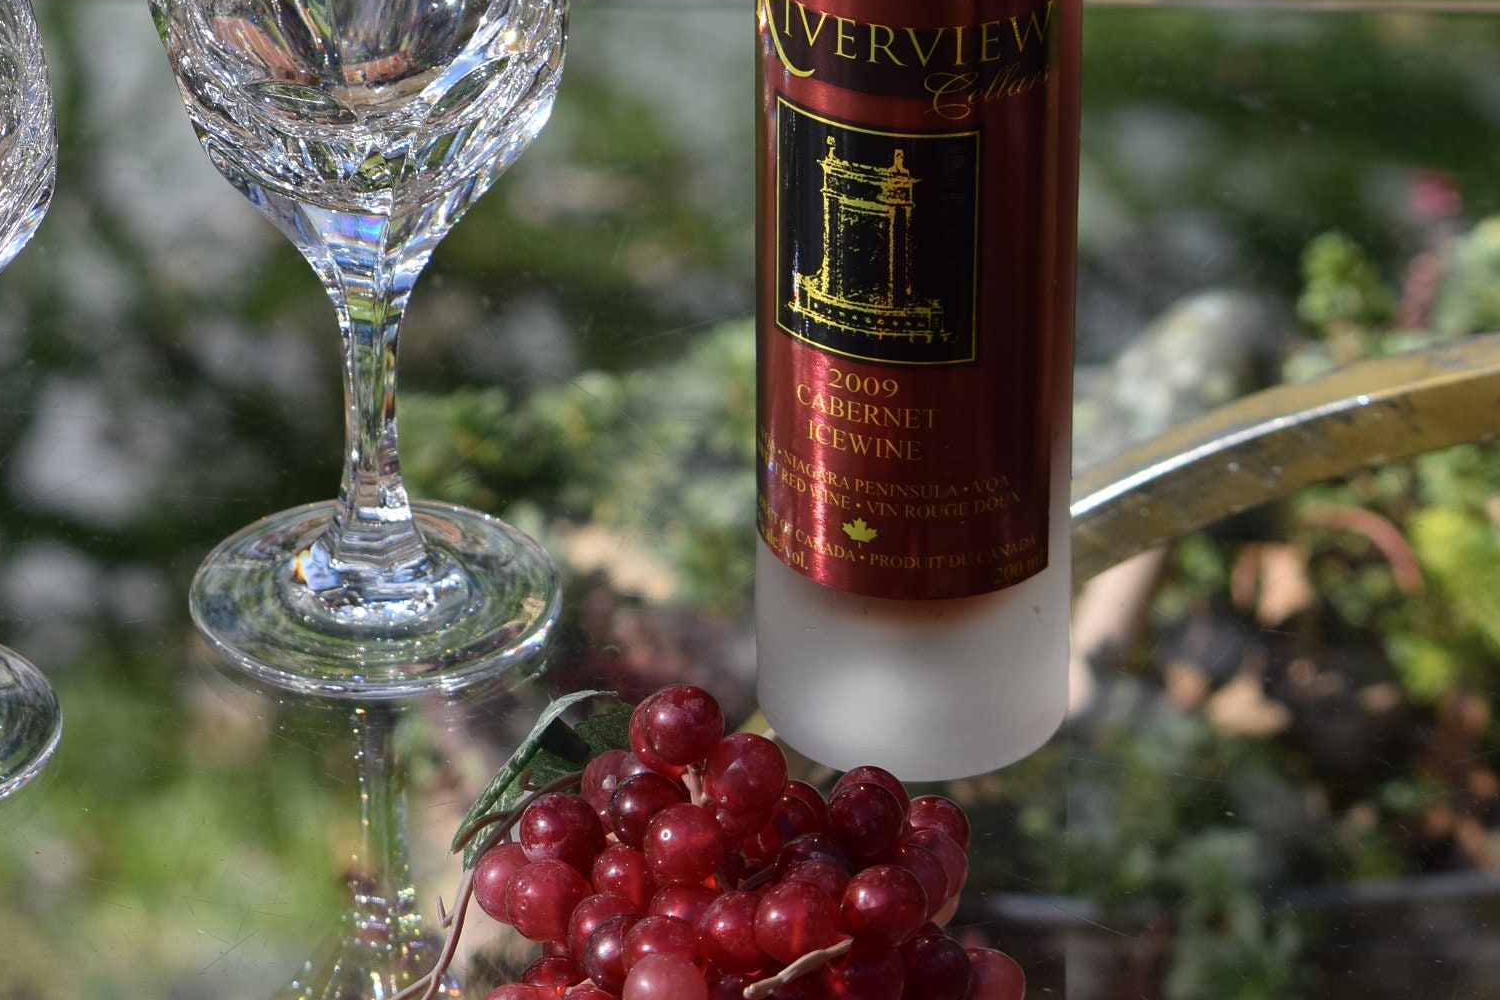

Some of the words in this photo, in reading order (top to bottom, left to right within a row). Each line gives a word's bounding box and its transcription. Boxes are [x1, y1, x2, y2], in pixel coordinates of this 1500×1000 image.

[924, 63, 1052, 121] Cellars
[796, 383, 940, 430] CABERNET
[828, 368, 899, 398] 2009
[808, 418, 923, 462] ICEWINE
[781, 467, 807, 493] RED
[810, 483, 851, 510] WINE
[866, 500, 898, 518] VIN
[904, 502, 970, 520] ROUGE
[974, 488, 1021, 515] DOUX
[783, 449, 851, 491] NIAGARA
[855, 478, 959, 499] PENINSULA
[973, 475, 1011, 495] VQA
[780, 518, 794, 536] OF
[795, 529, 857, 563] CANADA
[869, 552, 946, 569] PRODUIT
[949, 554, 973, 569] DU
[976, 535, 1037, 565] CANADA
[993, 560, 1023, 585] 200
